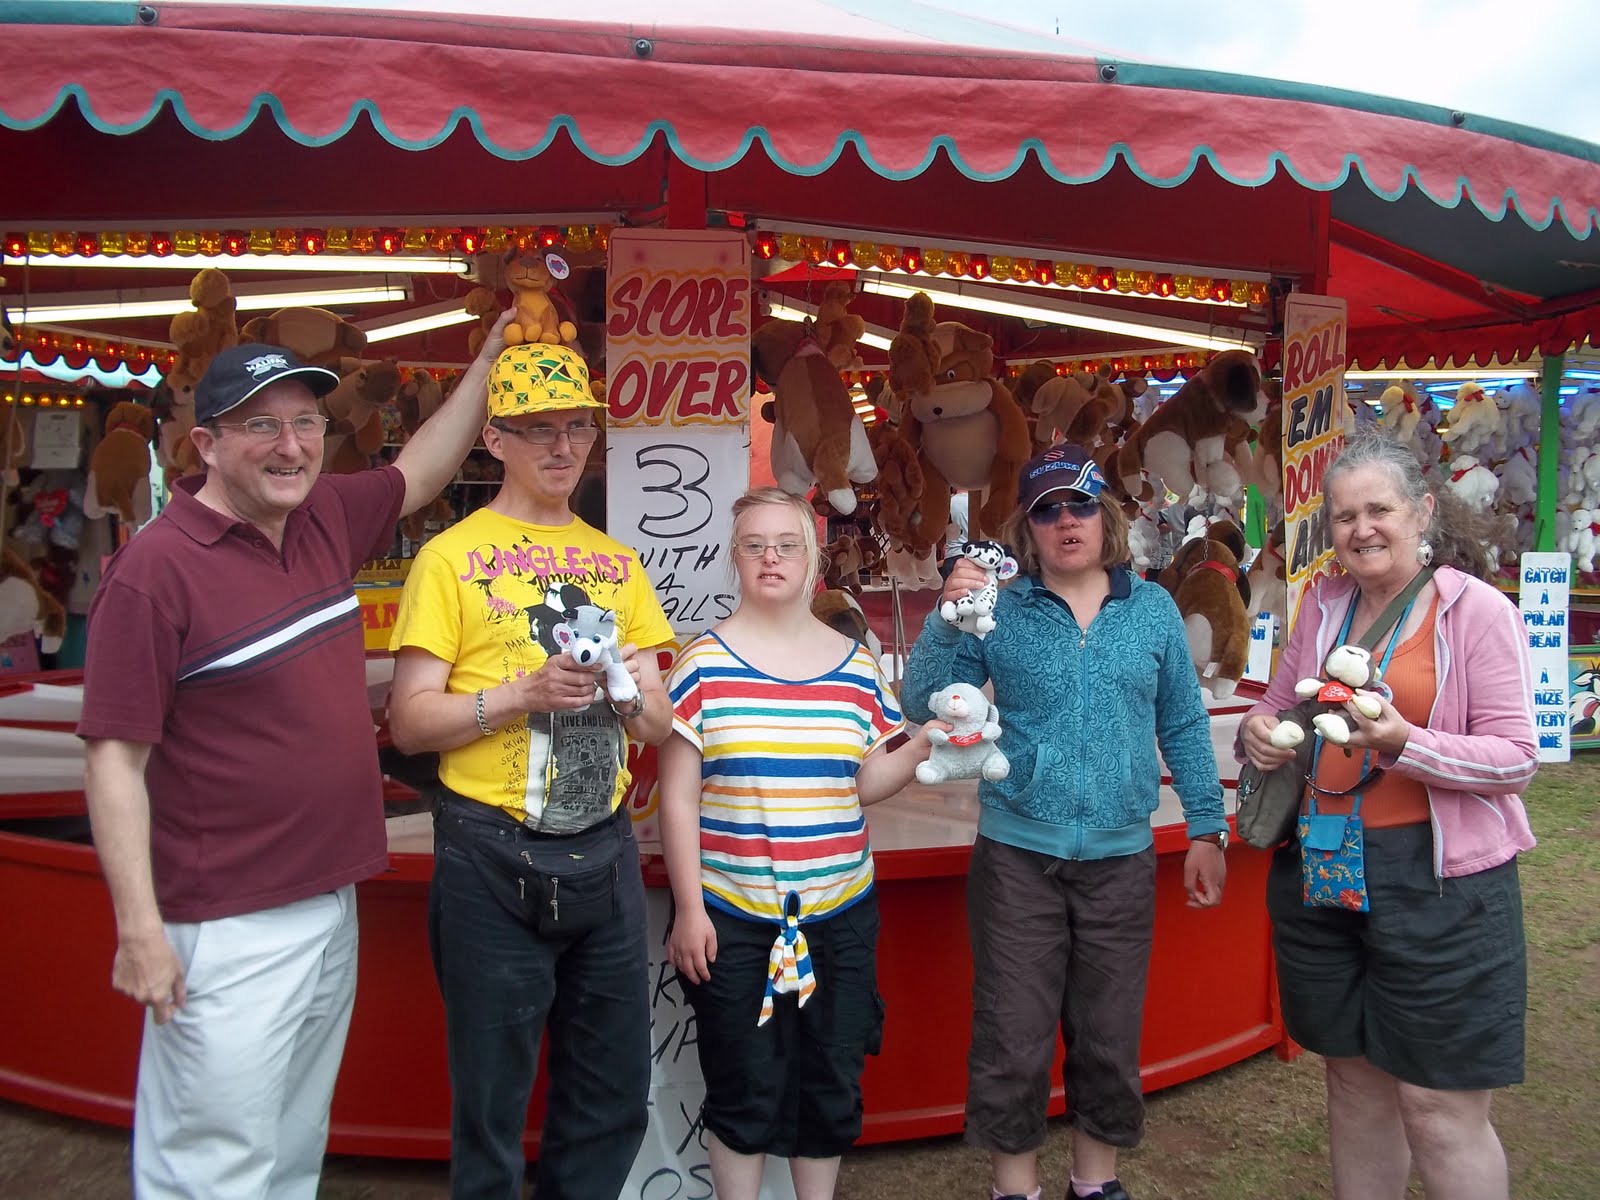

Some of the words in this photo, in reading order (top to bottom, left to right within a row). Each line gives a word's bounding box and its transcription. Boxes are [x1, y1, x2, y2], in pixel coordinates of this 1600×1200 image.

[607, 277, 749, 338] SCORE
[1284, 323, 1344, 393] ROLL
[607, 360, 747, 419] OVER
[1287, 384, 1333, 448] EM
[1029, 461, 1080, 479] SUZUKI
[636, 444, 713, 539] 3
[655, 572, 686, 595] 4
[1524, 567, 1567, 583] CATCH
[1540, 588, 1549, 604] A
[660, 593, 735, 622] ALLS
[1523, 610, 1565, 626] POLAR
[1528, 631, 1562, 648] BEAR
[1540, 667, 1549, 683] A
[1534, 688, 1564, 705] RIZE
[1535, 711, 1567, 727] VERY
